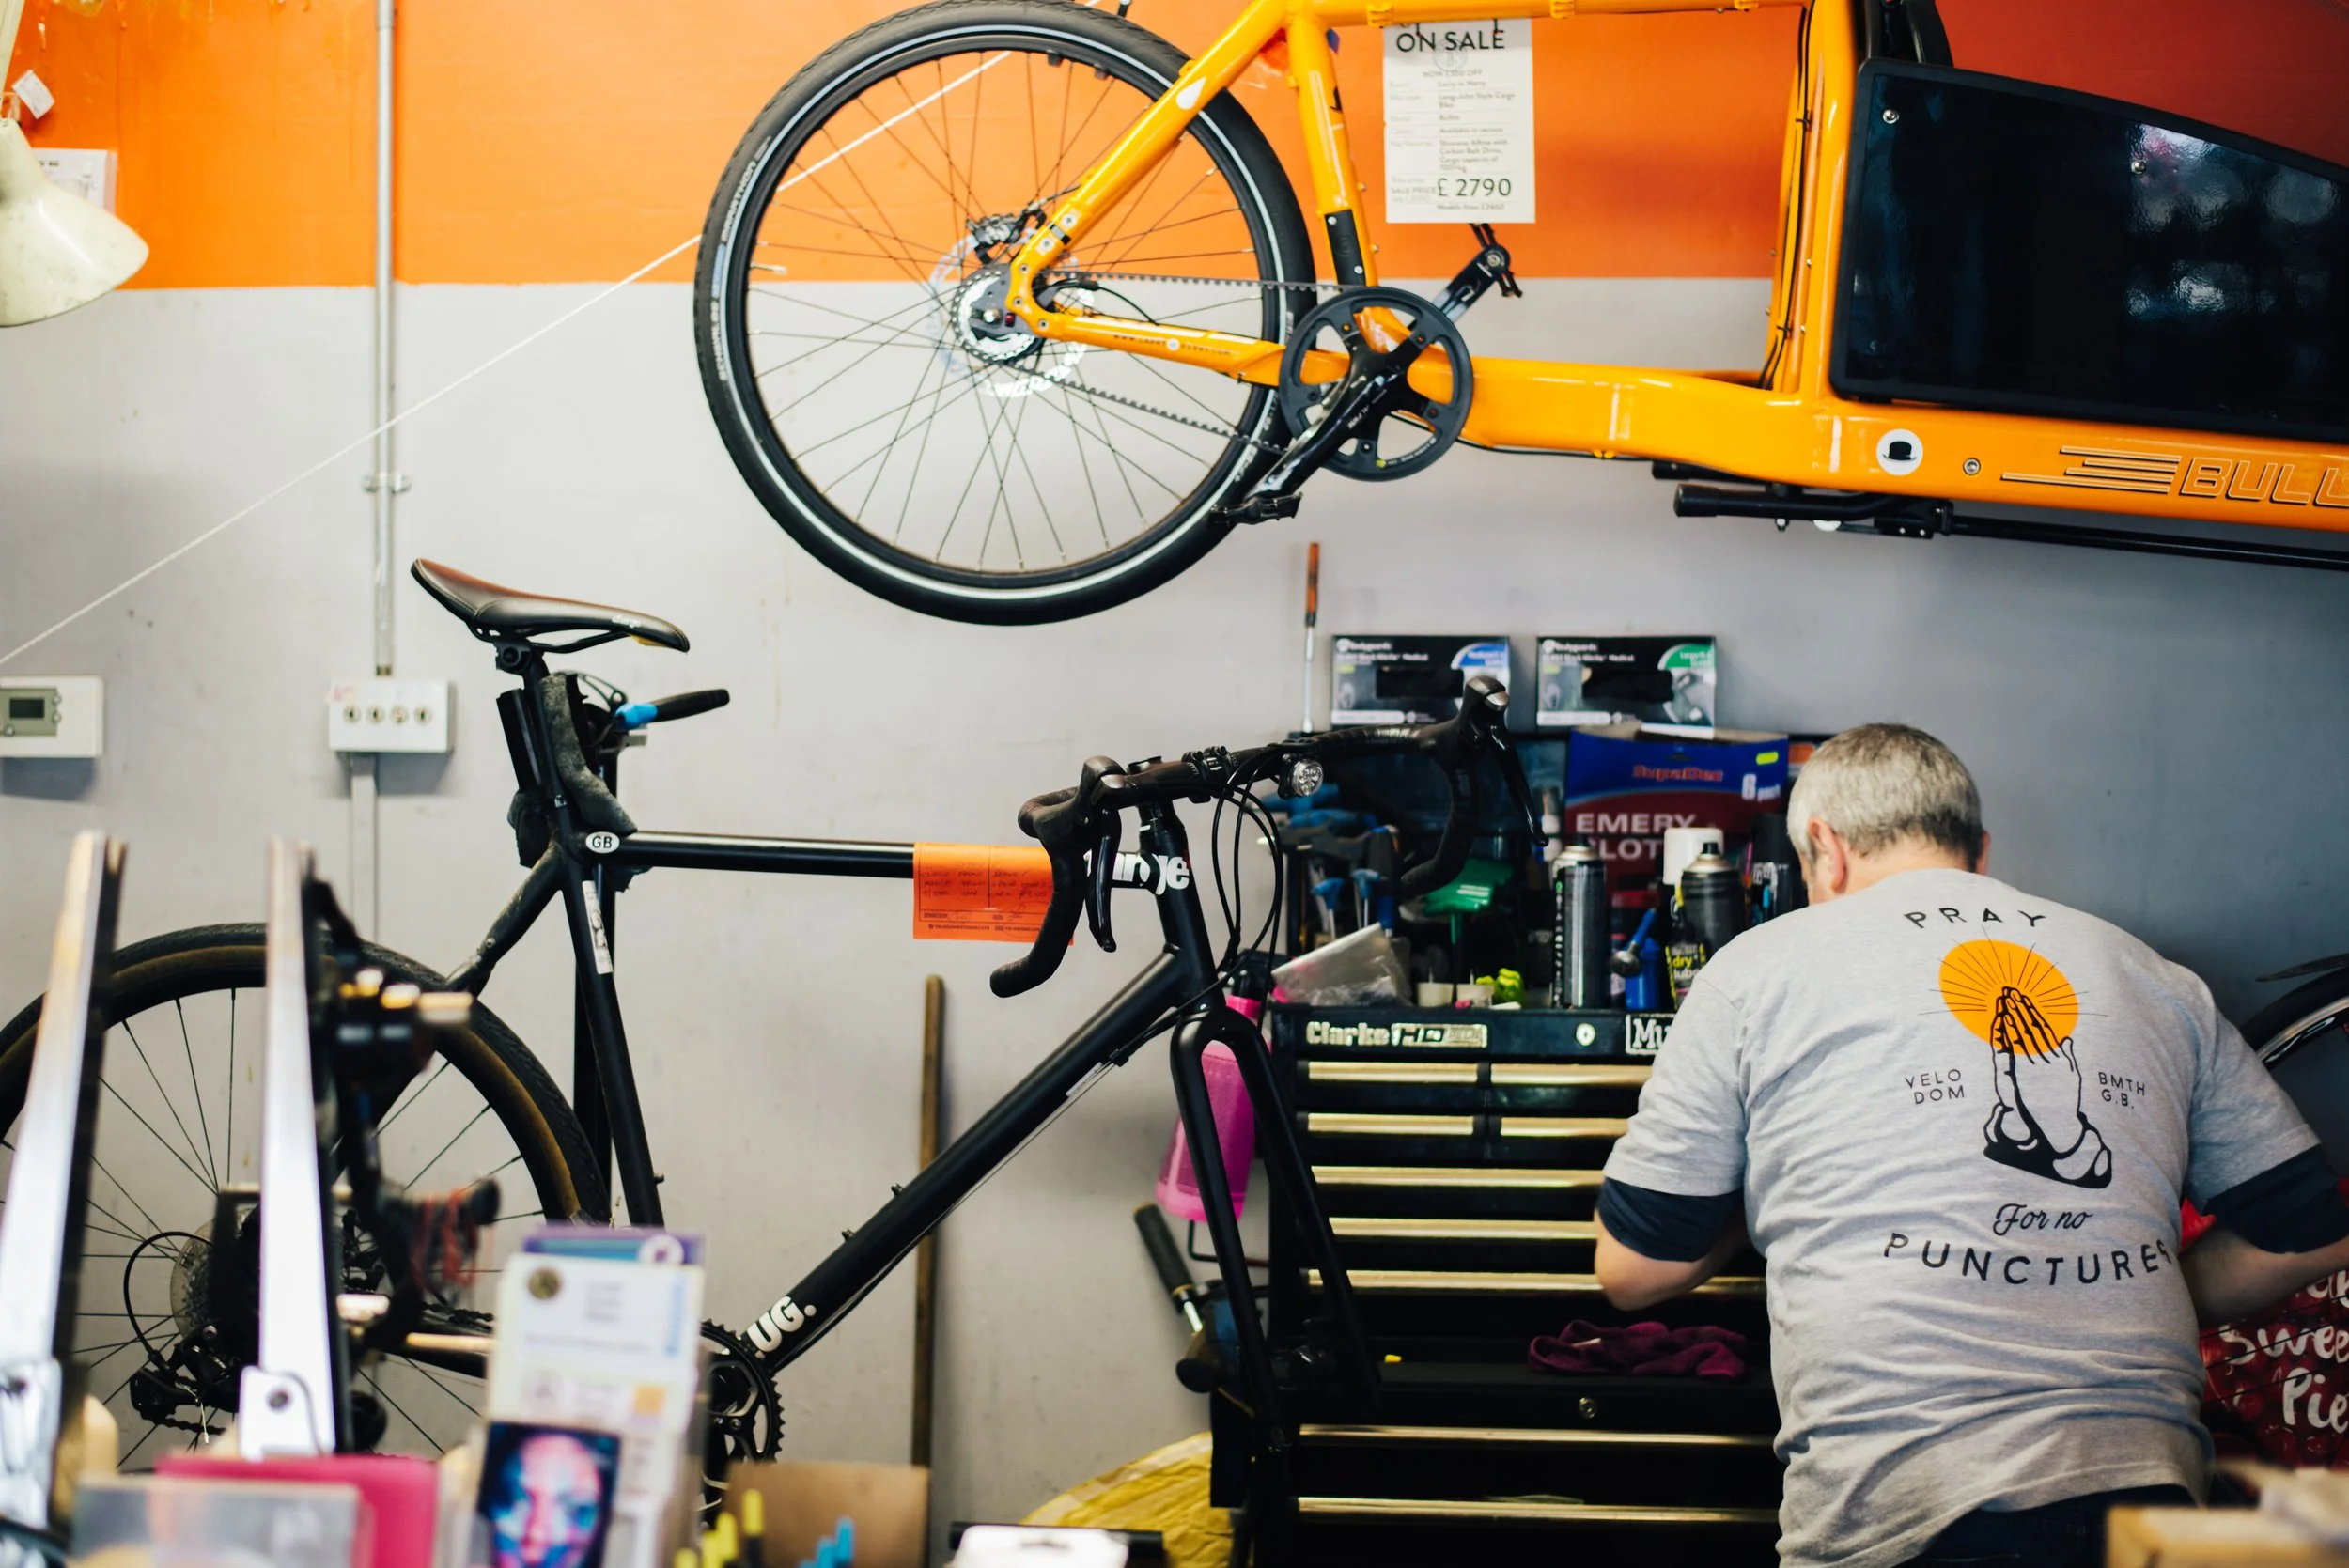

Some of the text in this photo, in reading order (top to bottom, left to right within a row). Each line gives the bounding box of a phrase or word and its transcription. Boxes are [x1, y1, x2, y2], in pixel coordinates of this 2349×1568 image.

[1396, 30, 1505, 53] ON SALE
[1438, 178, 1512, 197] £ 2790
[1576, 813, 1697, 834] EMERY
[592, 835, 613, 849] GB
[1903, 907, 2047, 929] PRAY
[1672, 955, 1692, 970] dry
[1305, 1020, 1391, 1046] Clarke
[1905, 1068, 1962, 1088] VELO
[2097, 1071, 2146, 1096] BMTH
[1914, 1085, 1966, 1106] DOM
[2101, 1088, 2135, 1110] G.B.
[1992, 1203, 2094, 1237] For no
[1882, 1231, 2173, 1287] PUNCTURES
[747, 1296, 817, 1359] UG.
[2281, 1367, 2349, 1435] Pie
